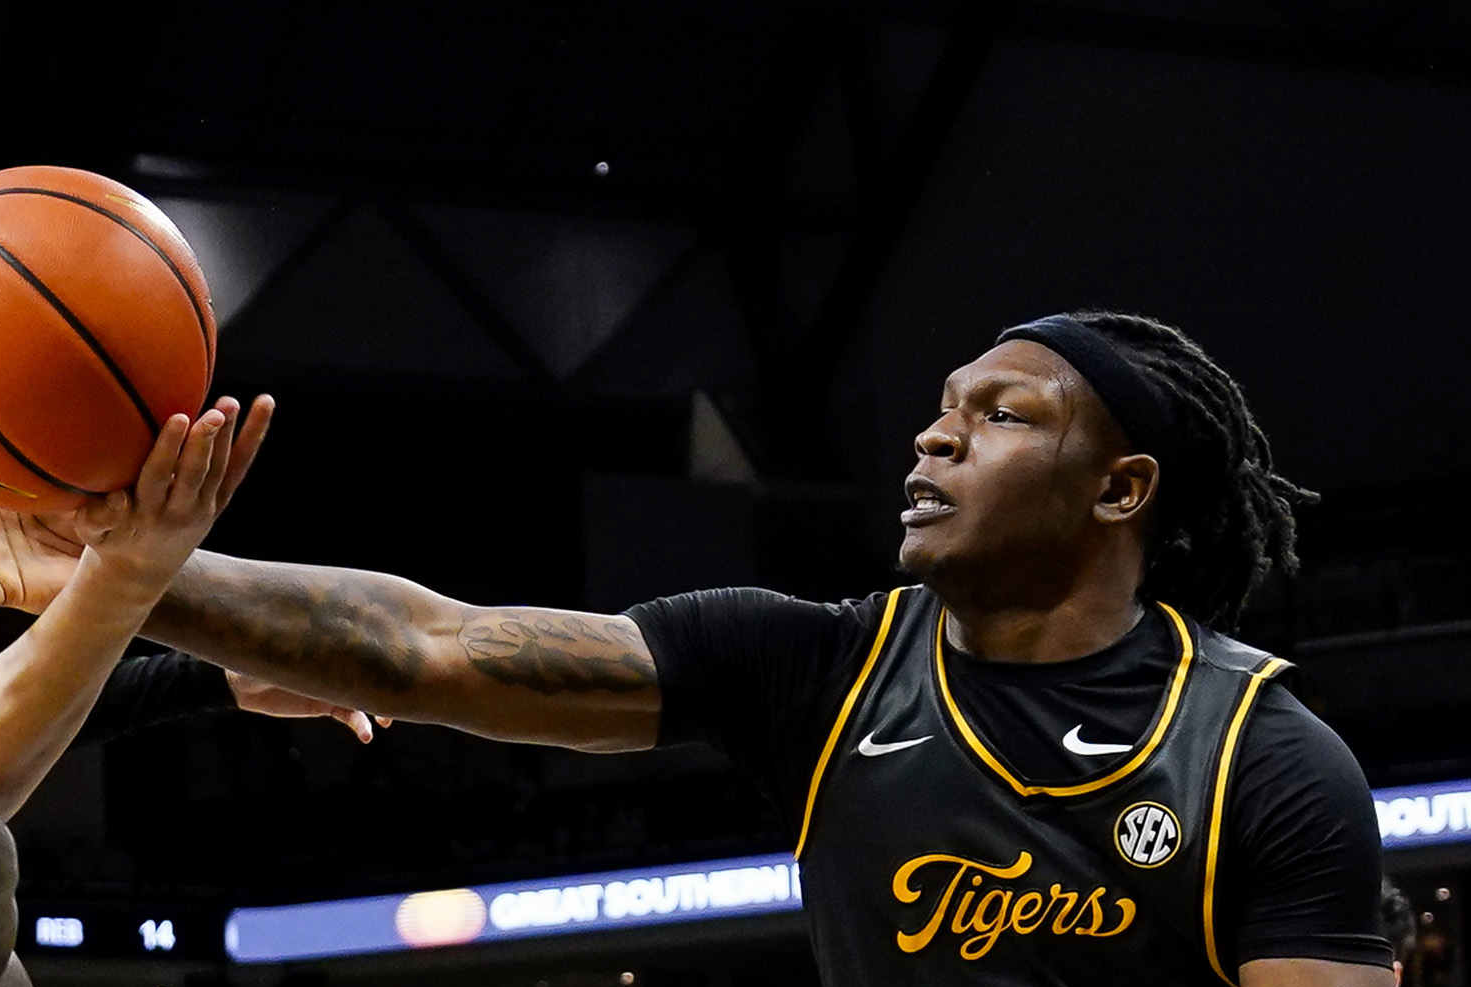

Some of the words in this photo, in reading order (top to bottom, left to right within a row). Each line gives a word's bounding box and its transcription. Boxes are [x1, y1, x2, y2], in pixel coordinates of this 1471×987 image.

[1119, 805, 1176, 864] SEC
[489, 884, 603, 930] GREAT
[603, 864, 790, 919] SOUTHERN
[892, 850, 1137, 961] Tigers
[139, 919, 176, 951] 14
